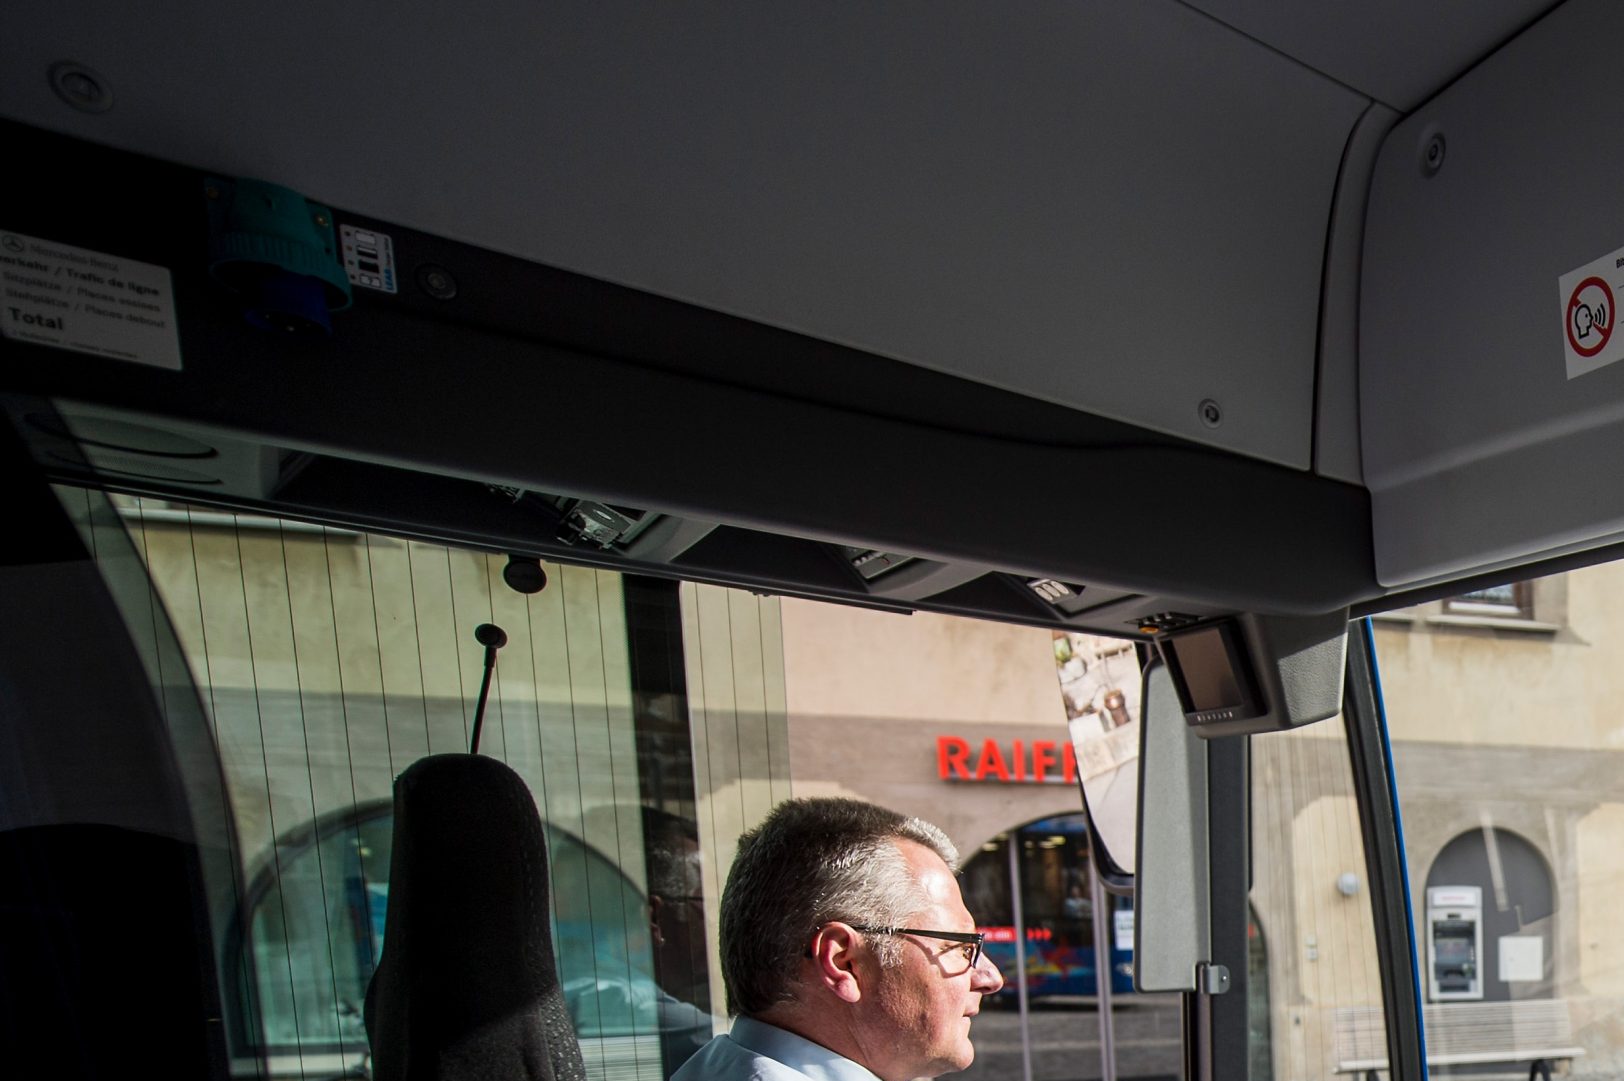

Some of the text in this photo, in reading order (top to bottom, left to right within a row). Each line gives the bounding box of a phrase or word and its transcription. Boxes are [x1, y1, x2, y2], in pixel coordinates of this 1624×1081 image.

[67, 268, 104, 283] Trafic
[108, 278, 124, 288] de
[128, 281, 159, 296] ligne
[77, 287, 115, 302] Places
[9, 307, 64, 330] Total
[85, 304, 123, 319] Places
[126, 314, 165, 327] debout
